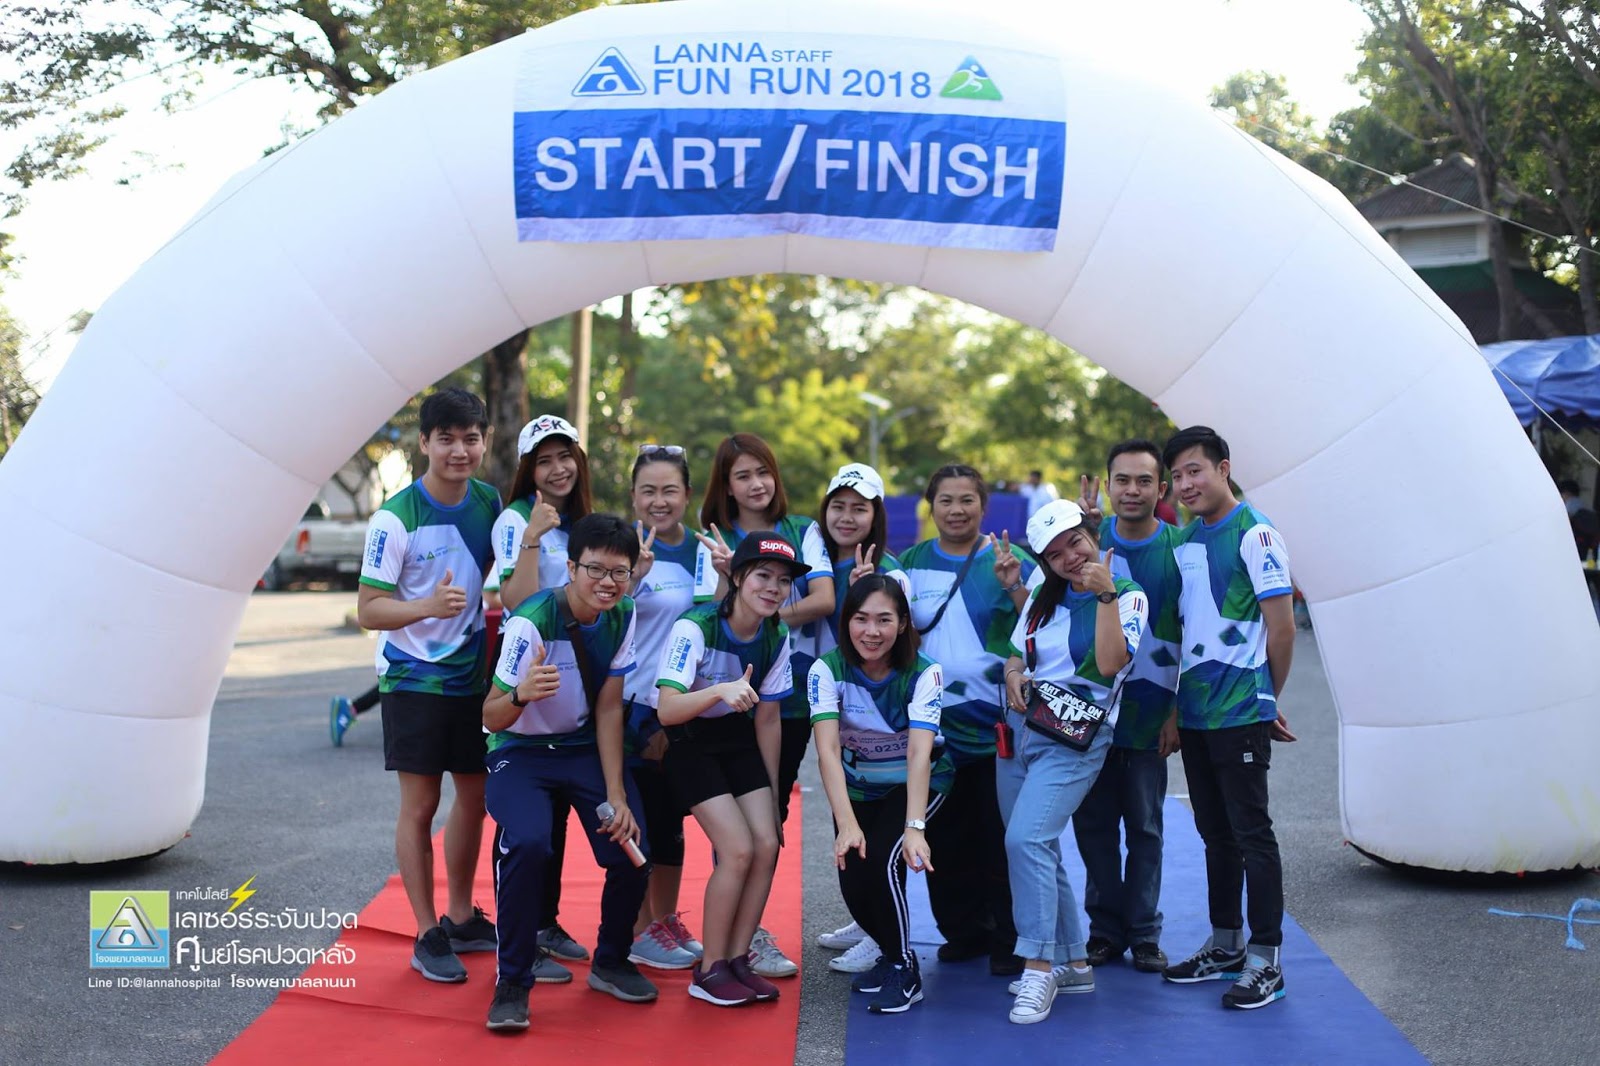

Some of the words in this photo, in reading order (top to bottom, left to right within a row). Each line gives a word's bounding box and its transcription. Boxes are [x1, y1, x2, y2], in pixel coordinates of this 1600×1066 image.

[654, 42, 767, 64] LANNA
[771, 50, 833, 62] STAFF
[653, 67, 730, 95] FUN
[750, 67, 830, 95] RUN
[842, 68, 931, 99] 2018
[760, 540, 796, 559] Suprem
[1040, 683, 1061, 695] ART
[1087, 705, 1103, 718] ON
